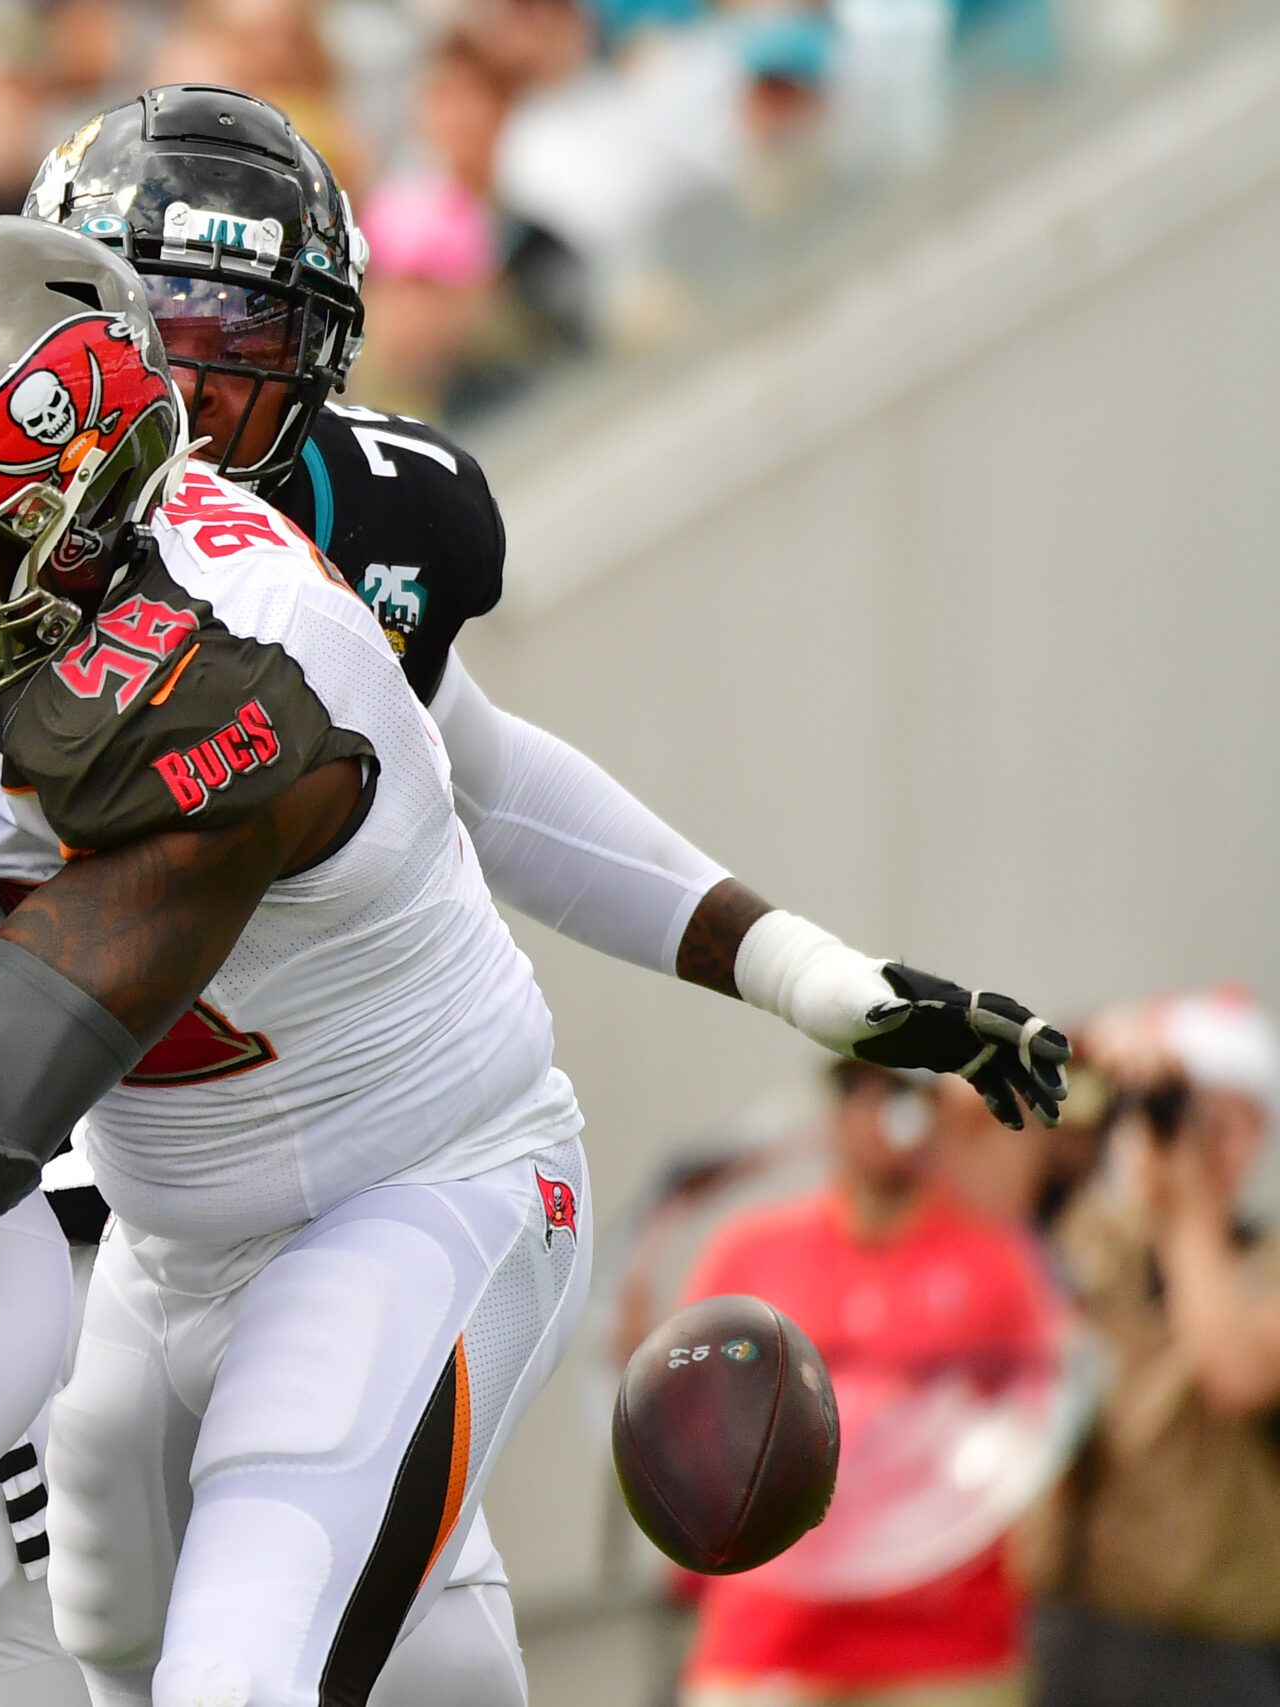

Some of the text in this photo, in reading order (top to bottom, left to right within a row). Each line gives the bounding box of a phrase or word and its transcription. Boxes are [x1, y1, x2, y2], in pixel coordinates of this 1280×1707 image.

[198, 218, 248, 249] JAX
[364, 562, 421, 626] 25
[51, 592, 200, 715] 58
[152, 696, 281, 816] BUCS
